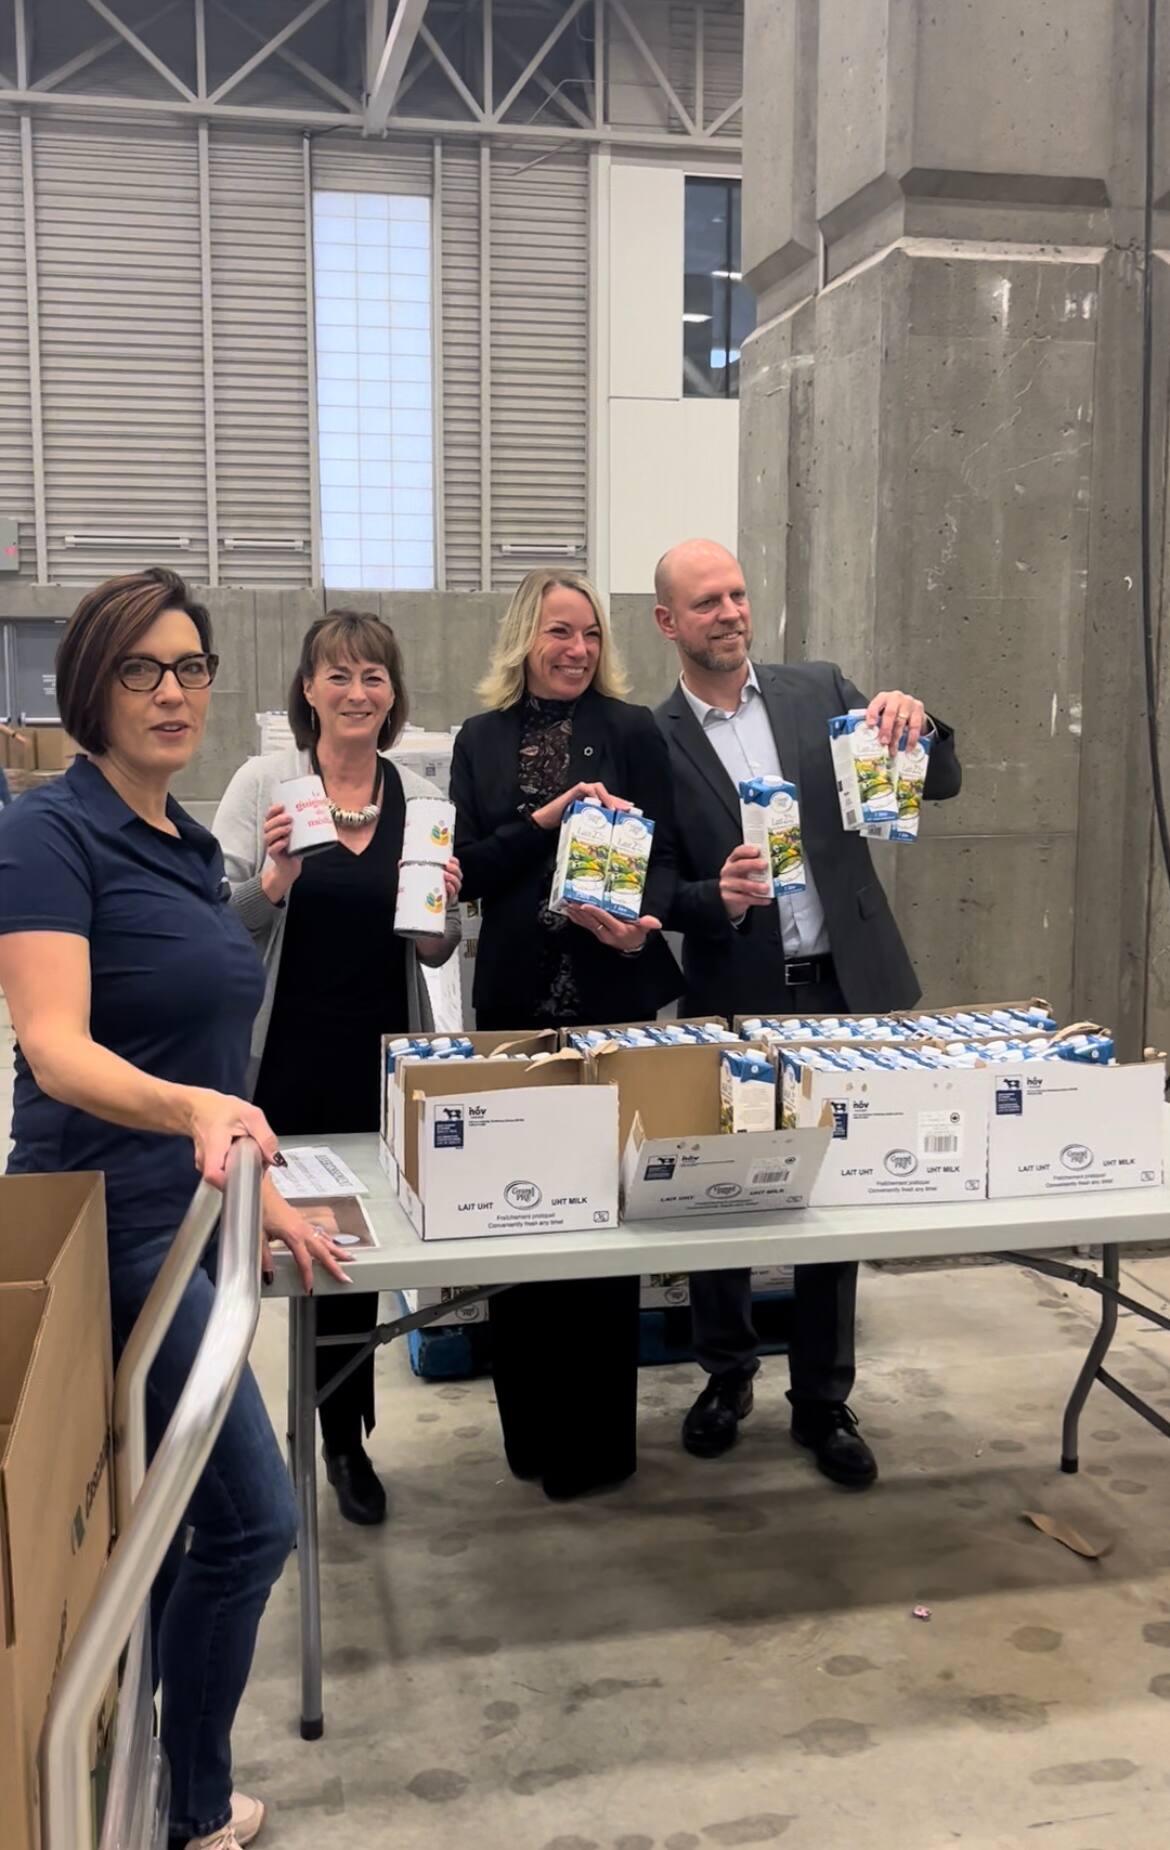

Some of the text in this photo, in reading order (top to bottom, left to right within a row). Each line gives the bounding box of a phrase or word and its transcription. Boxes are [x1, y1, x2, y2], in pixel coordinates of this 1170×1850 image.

[859, 1168, 874, 1176] UHT
[551, 1196, 588, 1206] UHT MILK
[458, 1202, 494, 1211] LAIT UHT
